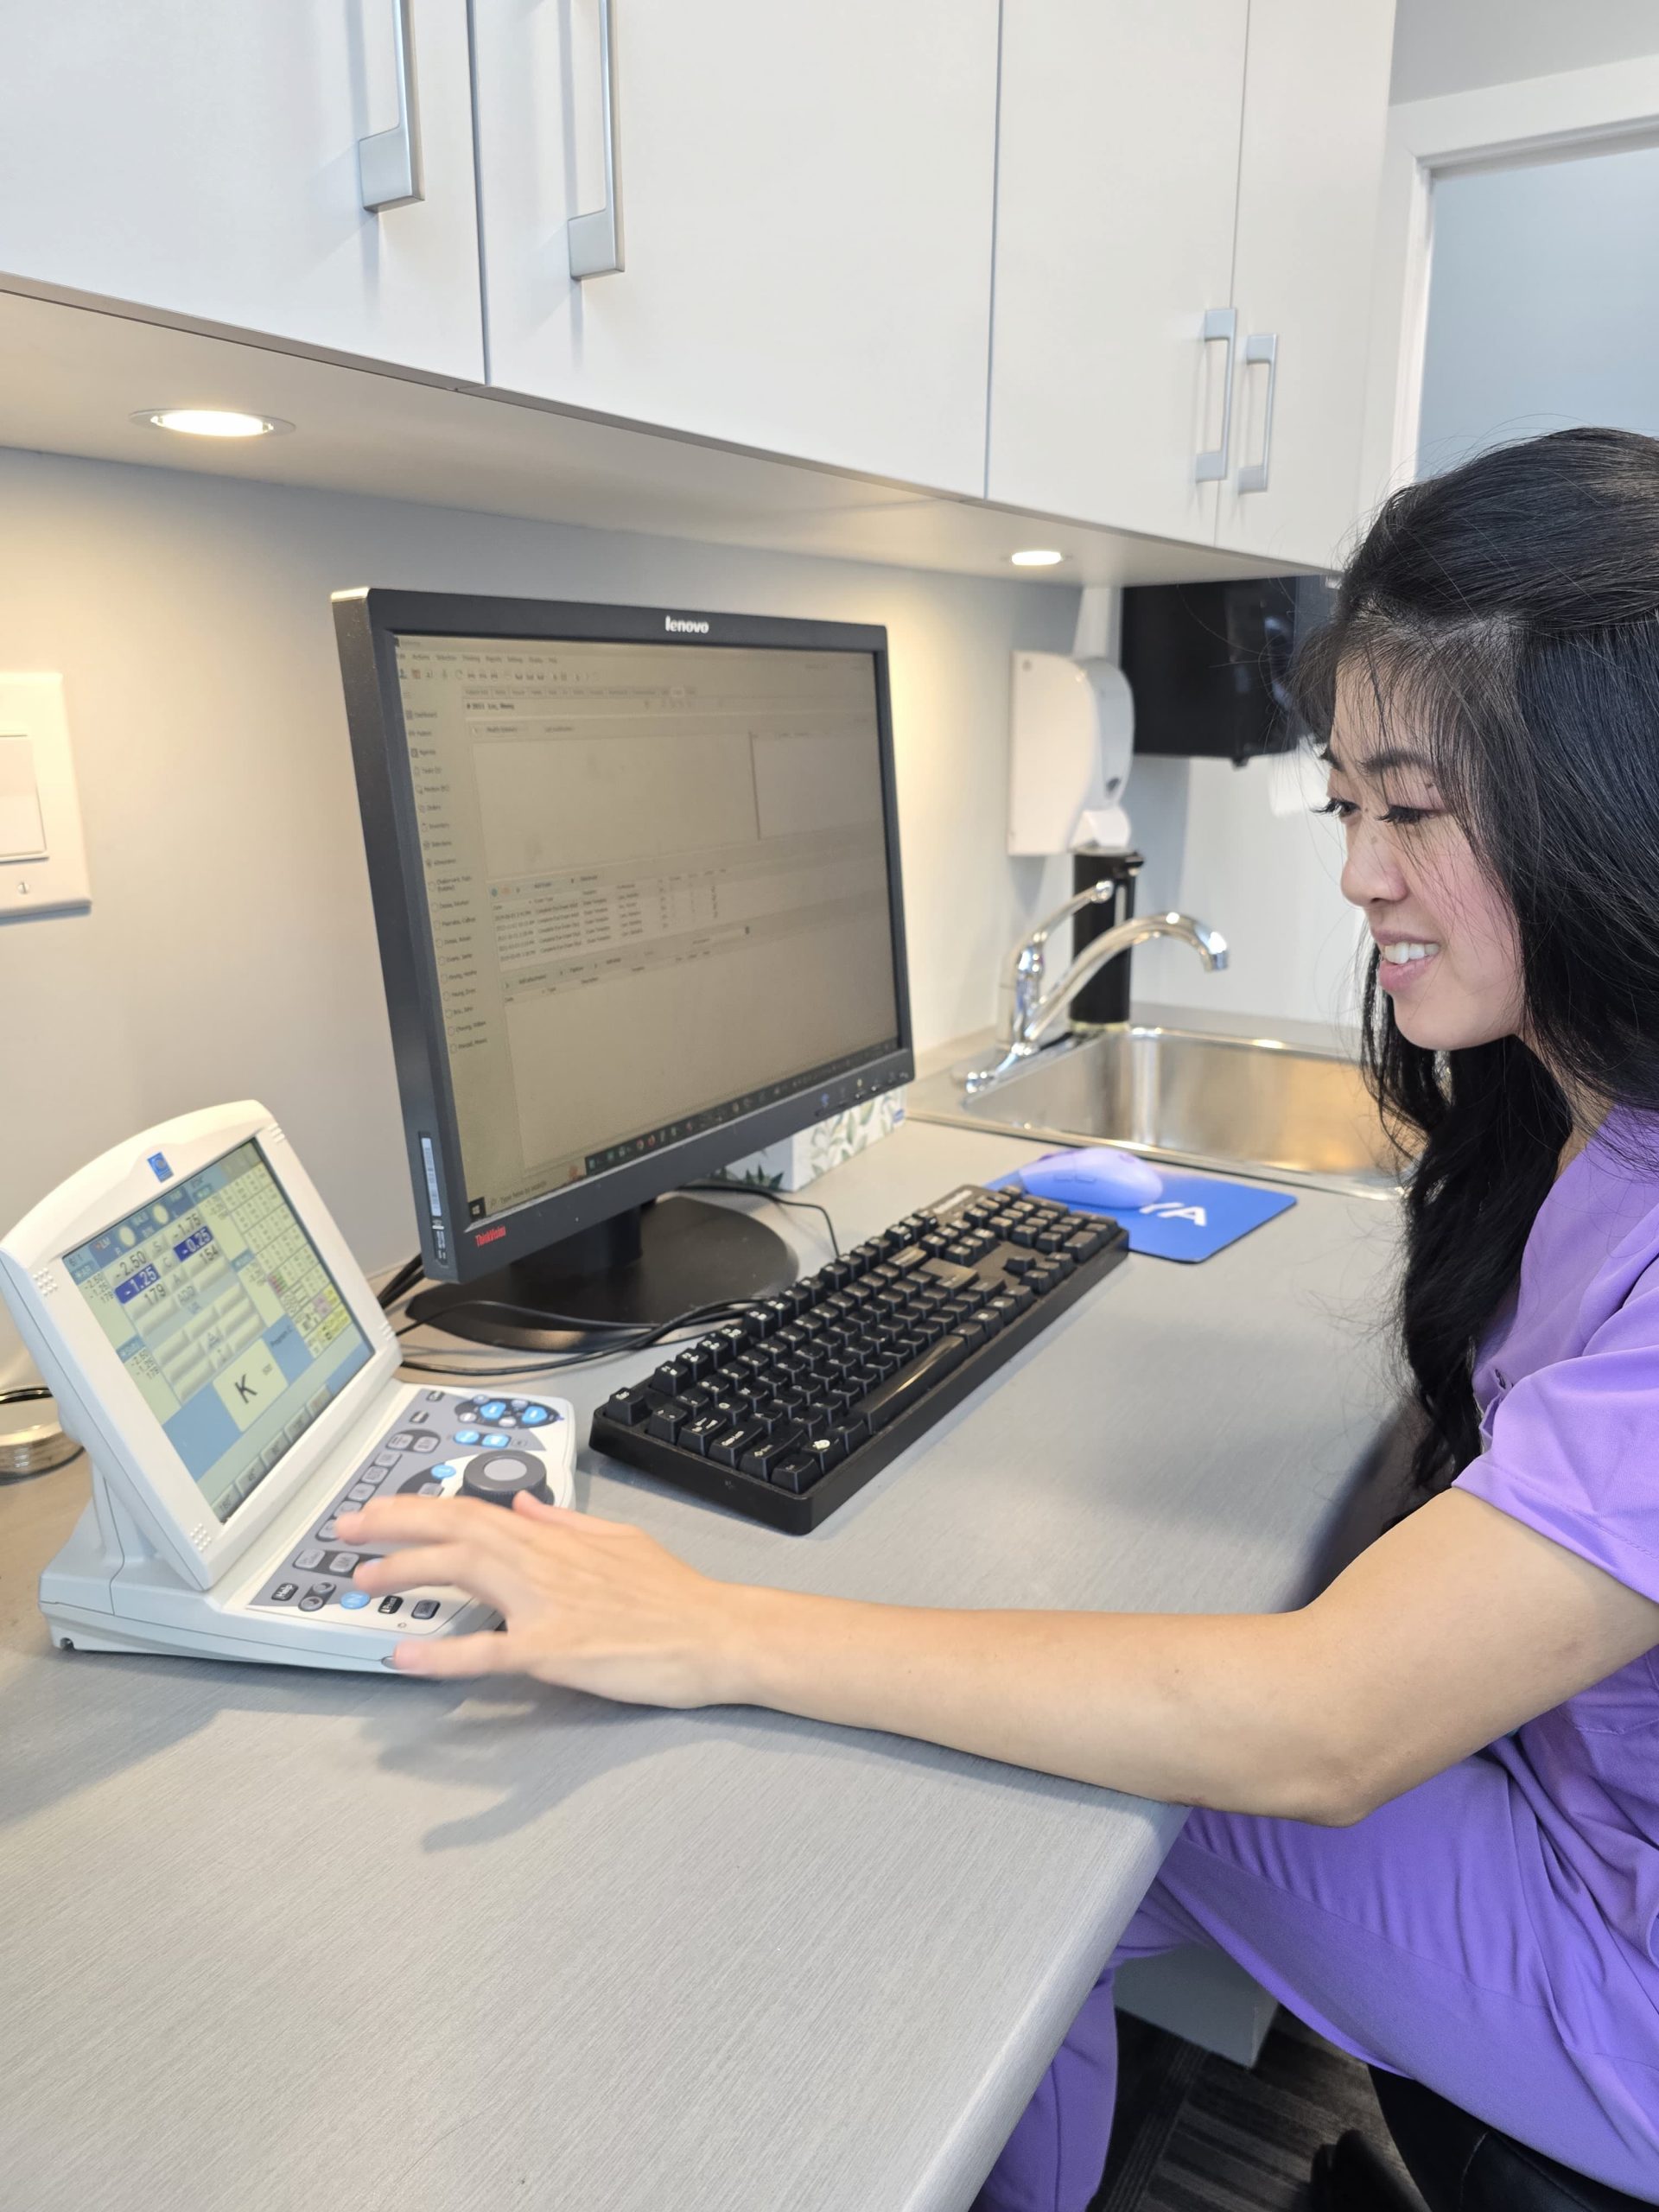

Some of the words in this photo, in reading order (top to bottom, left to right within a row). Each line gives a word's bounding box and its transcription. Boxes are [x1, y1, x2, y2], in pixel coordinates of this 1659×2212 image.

[664, 615, 709, 633] lenovo
[116, 1249, 147, 1278] -2.50
[174, 1213, 202, 1239] -1.75
[124, 1267, 157, 1296] -1.25
[181, 1228, 211, 1255] -0.25
[144, 1285, 166, 1306] 179
[200, 1244, 219, 1265] 154
[234, 1373, 258, 1404] K
[276, 1584, 294, 1598] Help
